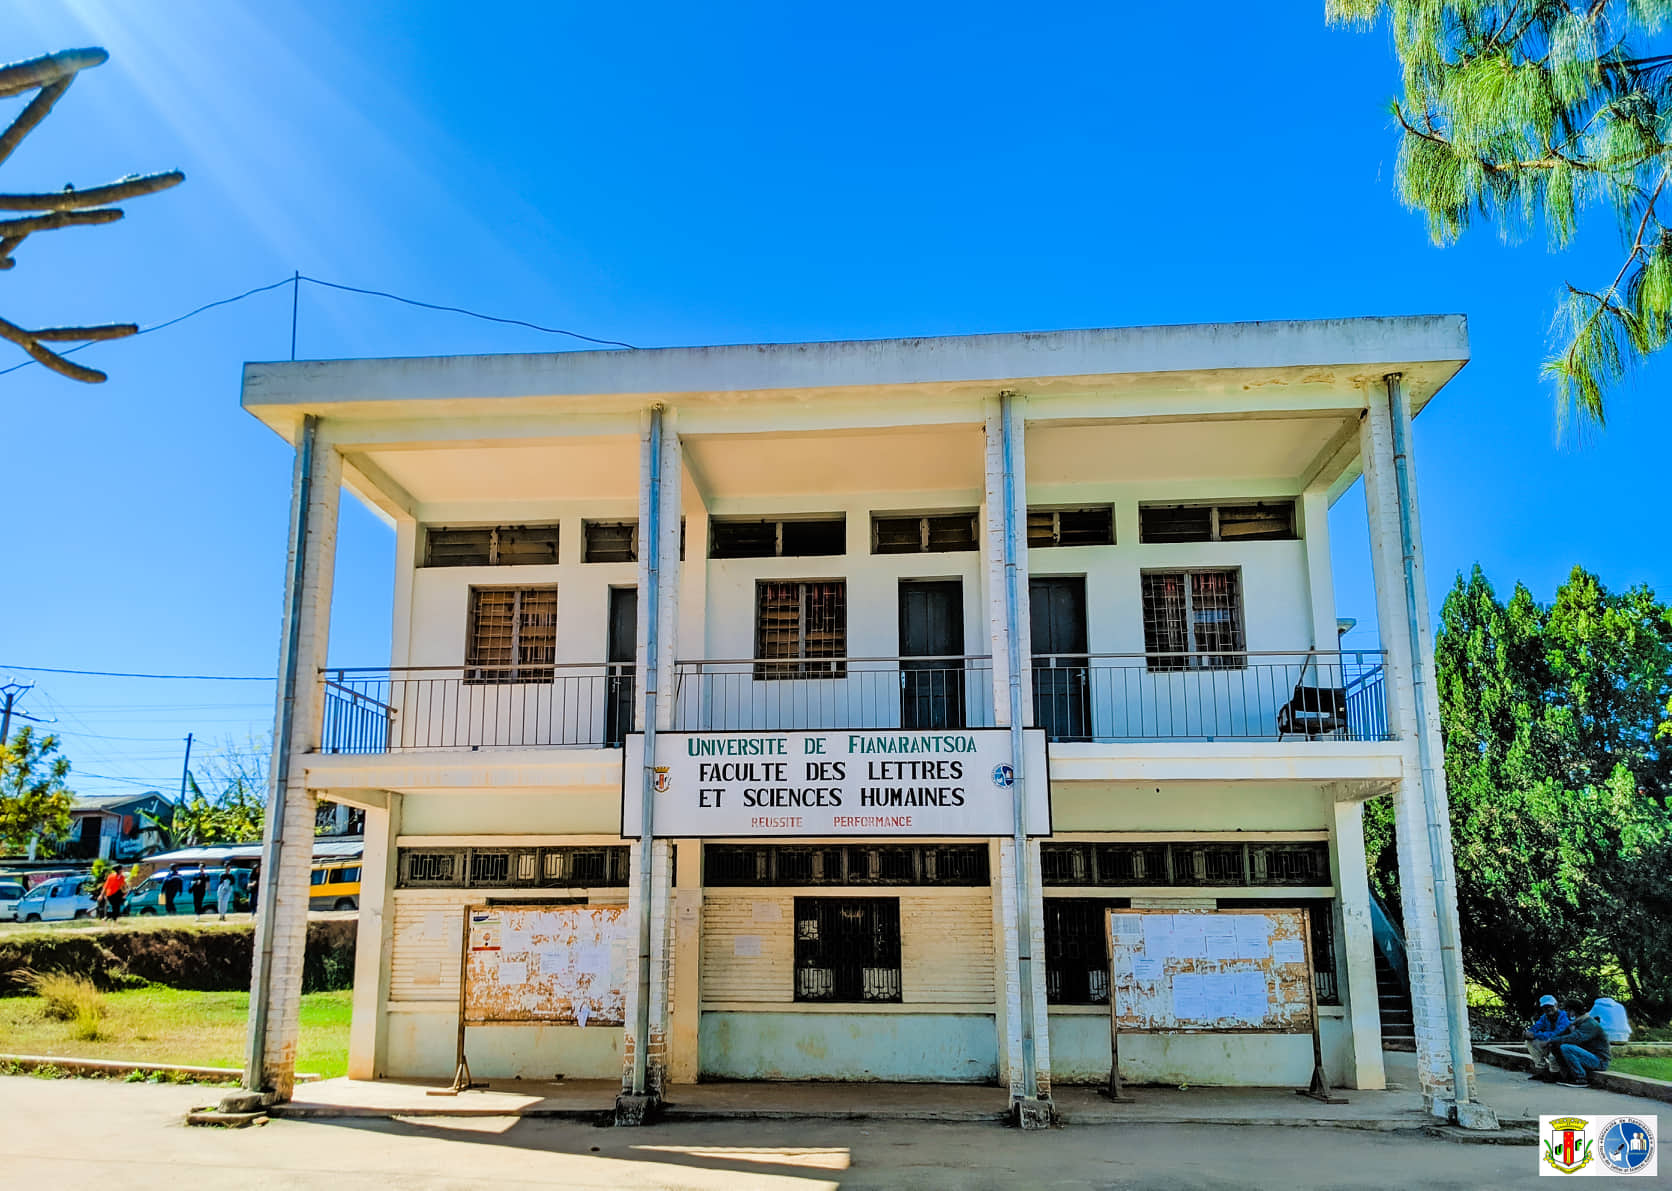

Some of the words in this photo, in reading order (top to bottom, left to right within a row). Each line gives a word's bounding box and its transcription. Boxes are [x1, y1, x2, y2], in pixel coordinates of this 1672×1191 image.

[687, 738, 788, 756] UNIVERSITE
[804, 737, 827, 755] DE
[848, 735, 977, 754] FIANARANTSOA
[699, 763, 788, 782] FACULTE
[806, 761, 846, 781] DES
[868, 760, 963, 780] LETTRES
[699, 788, 726, 808] ET
[743, 787, 843, 807] SCIENCES
[860, 787, 965, 807] HUMAINES
[751, 816, 803, 828] REUSSITE
[833, 816, 912, 827] PERFORMANCE
